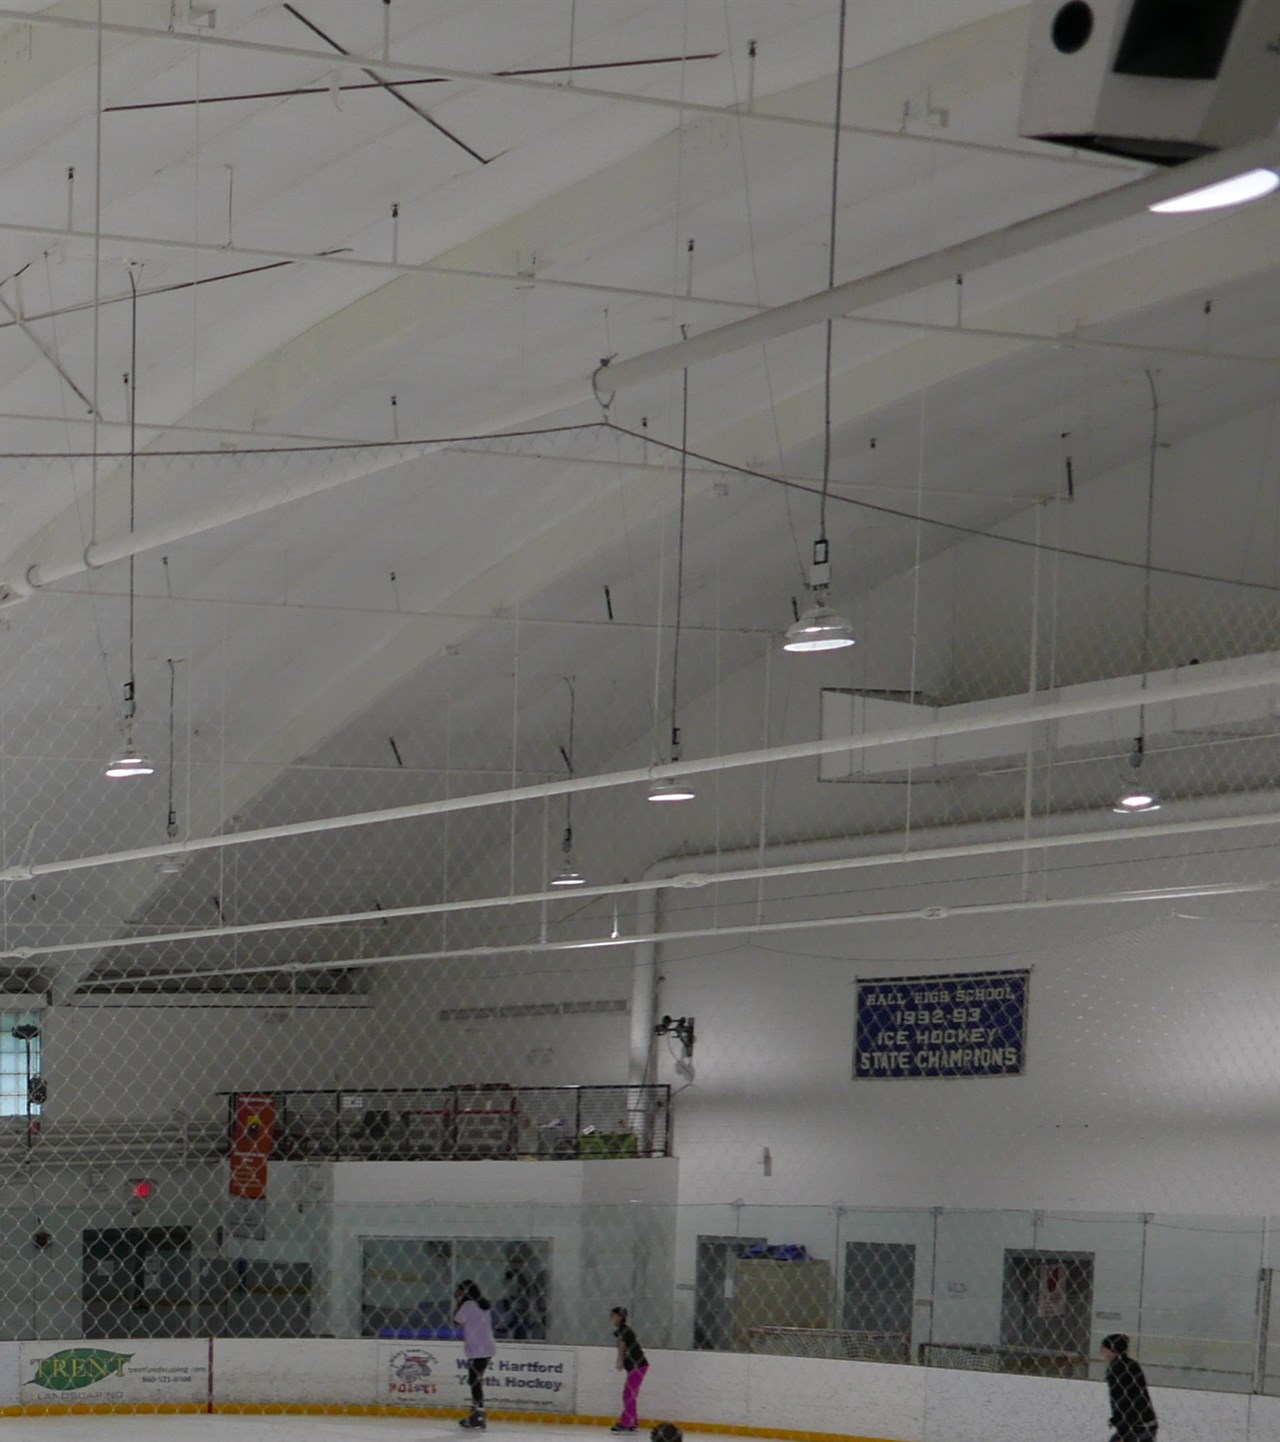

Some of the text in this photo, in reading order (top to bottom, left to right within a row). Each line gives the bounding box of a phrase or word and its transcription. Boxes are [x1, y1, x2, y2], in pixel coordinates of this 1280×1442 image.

[866, 987, 1016, 1005] HALL HIGH SCHOOL
[895, 1007, 981, 1025] 1992-93
[877, 1027, 998, 1046] ICE HOCKEY
[861, 1047, 1017, 1069] STATE CHAMPIONS
[30, 1357, 131, 1378] TRENT
[499, 1360, 564, 1374] Hartford
[505, 1377, 562, 1393] Hockey
[37, 1391, 124, 1400] LANDSCAPING
